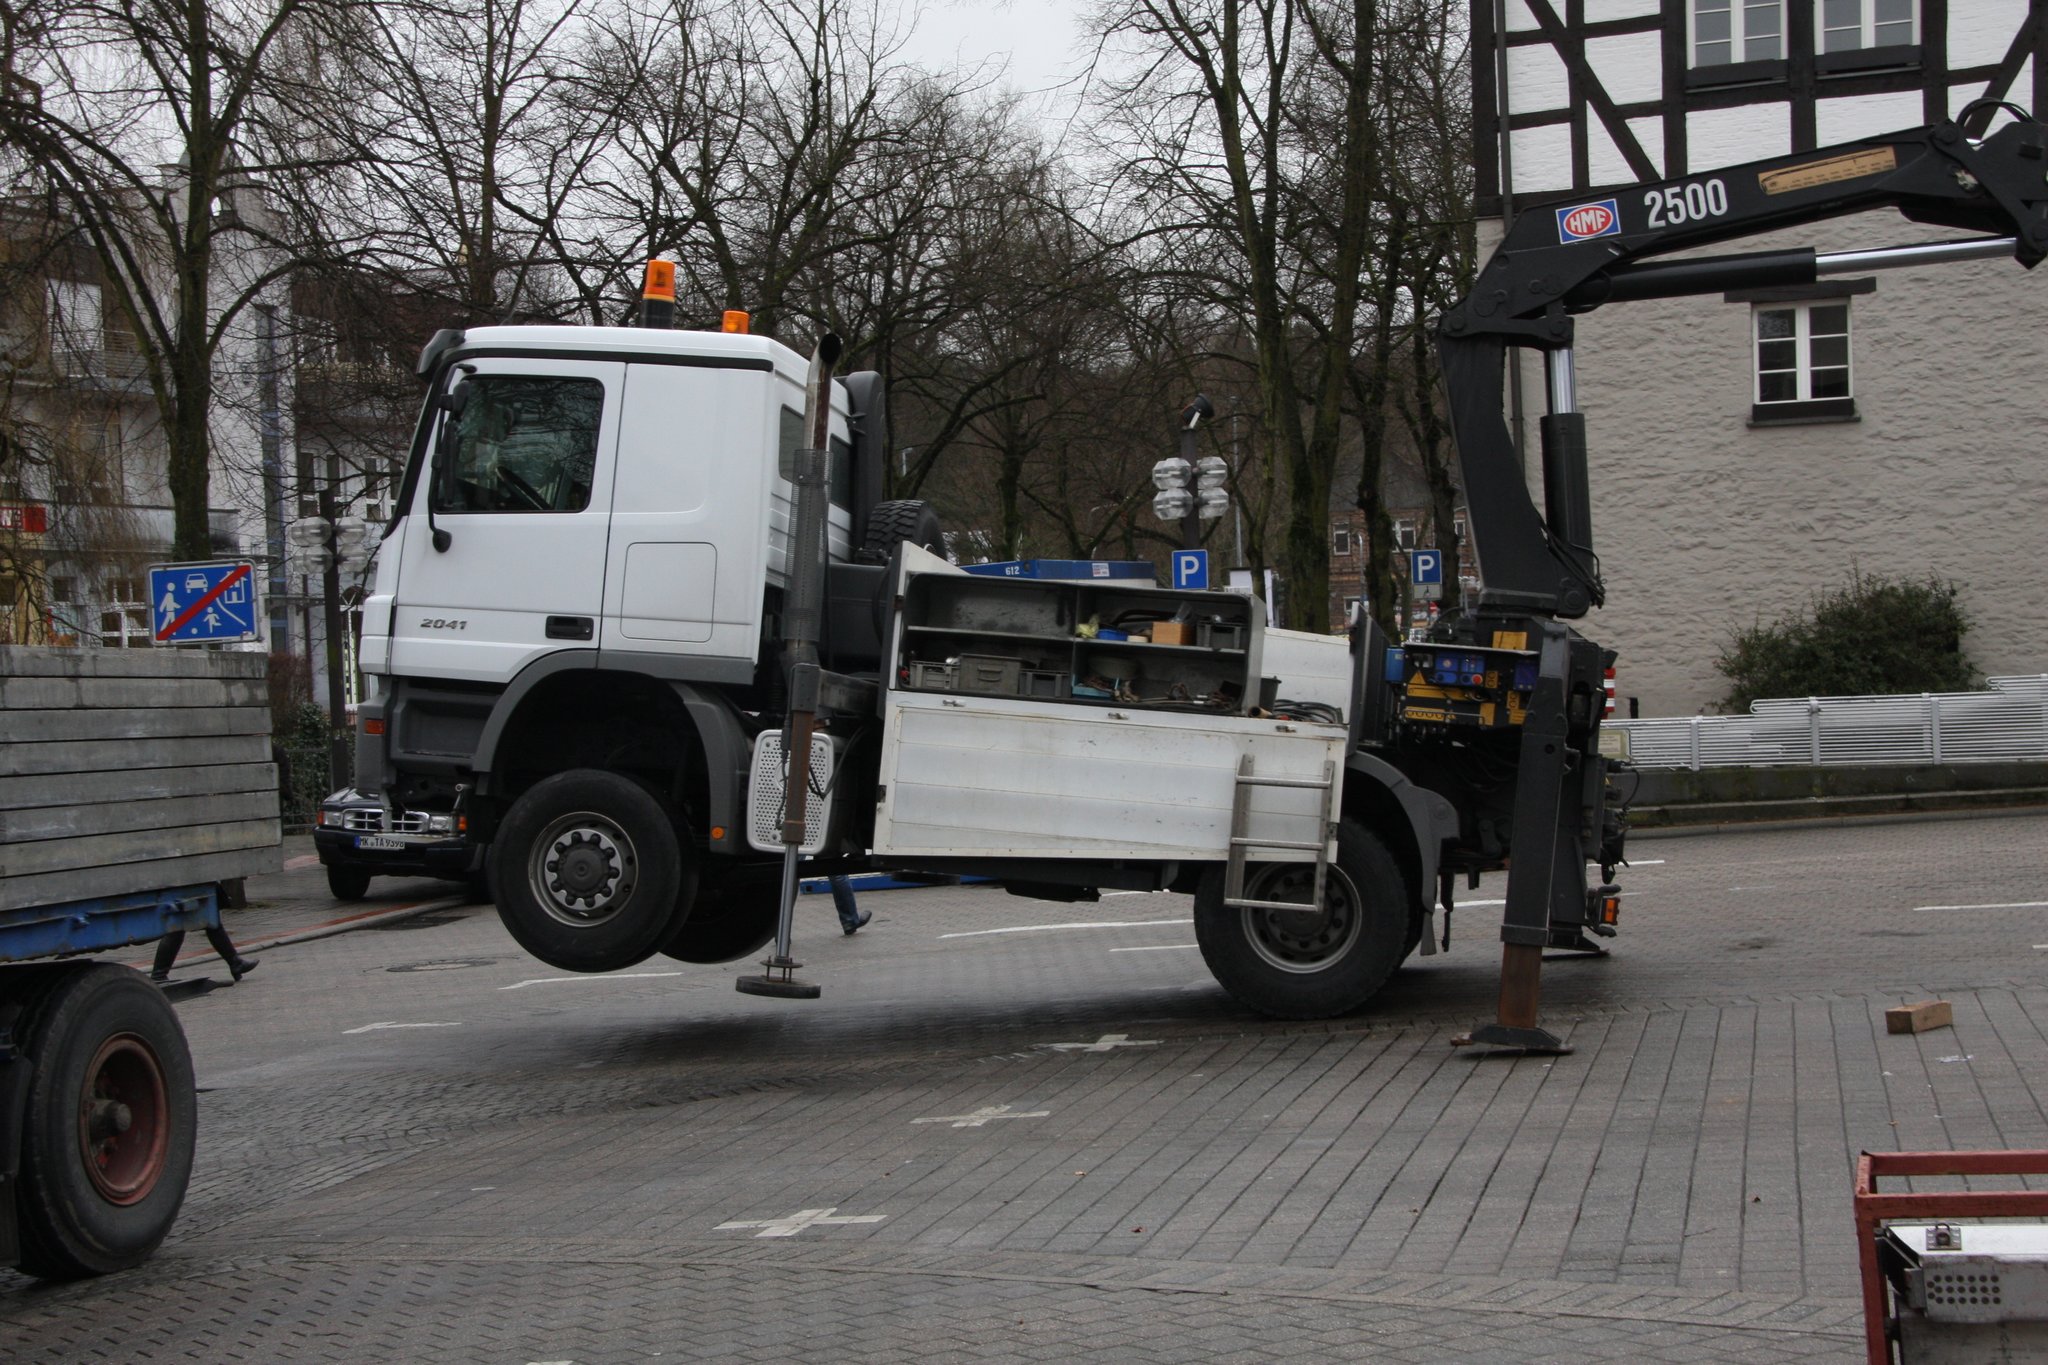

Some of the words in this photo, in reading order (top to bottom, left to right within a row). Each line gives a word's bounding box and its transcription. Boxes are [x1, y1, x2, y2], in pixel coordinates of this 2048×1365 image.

[1644, 178, 1728, 229] 2500
[1570, 210, 1607, 233] HMF
[1005, 566, 1020, 575] 612
[1180, 555, 1200, 586] P
[1417, 555, 1435, 582] P
[420, 618, 467, 630] 2041
[375, 837, 385, 846] TA
